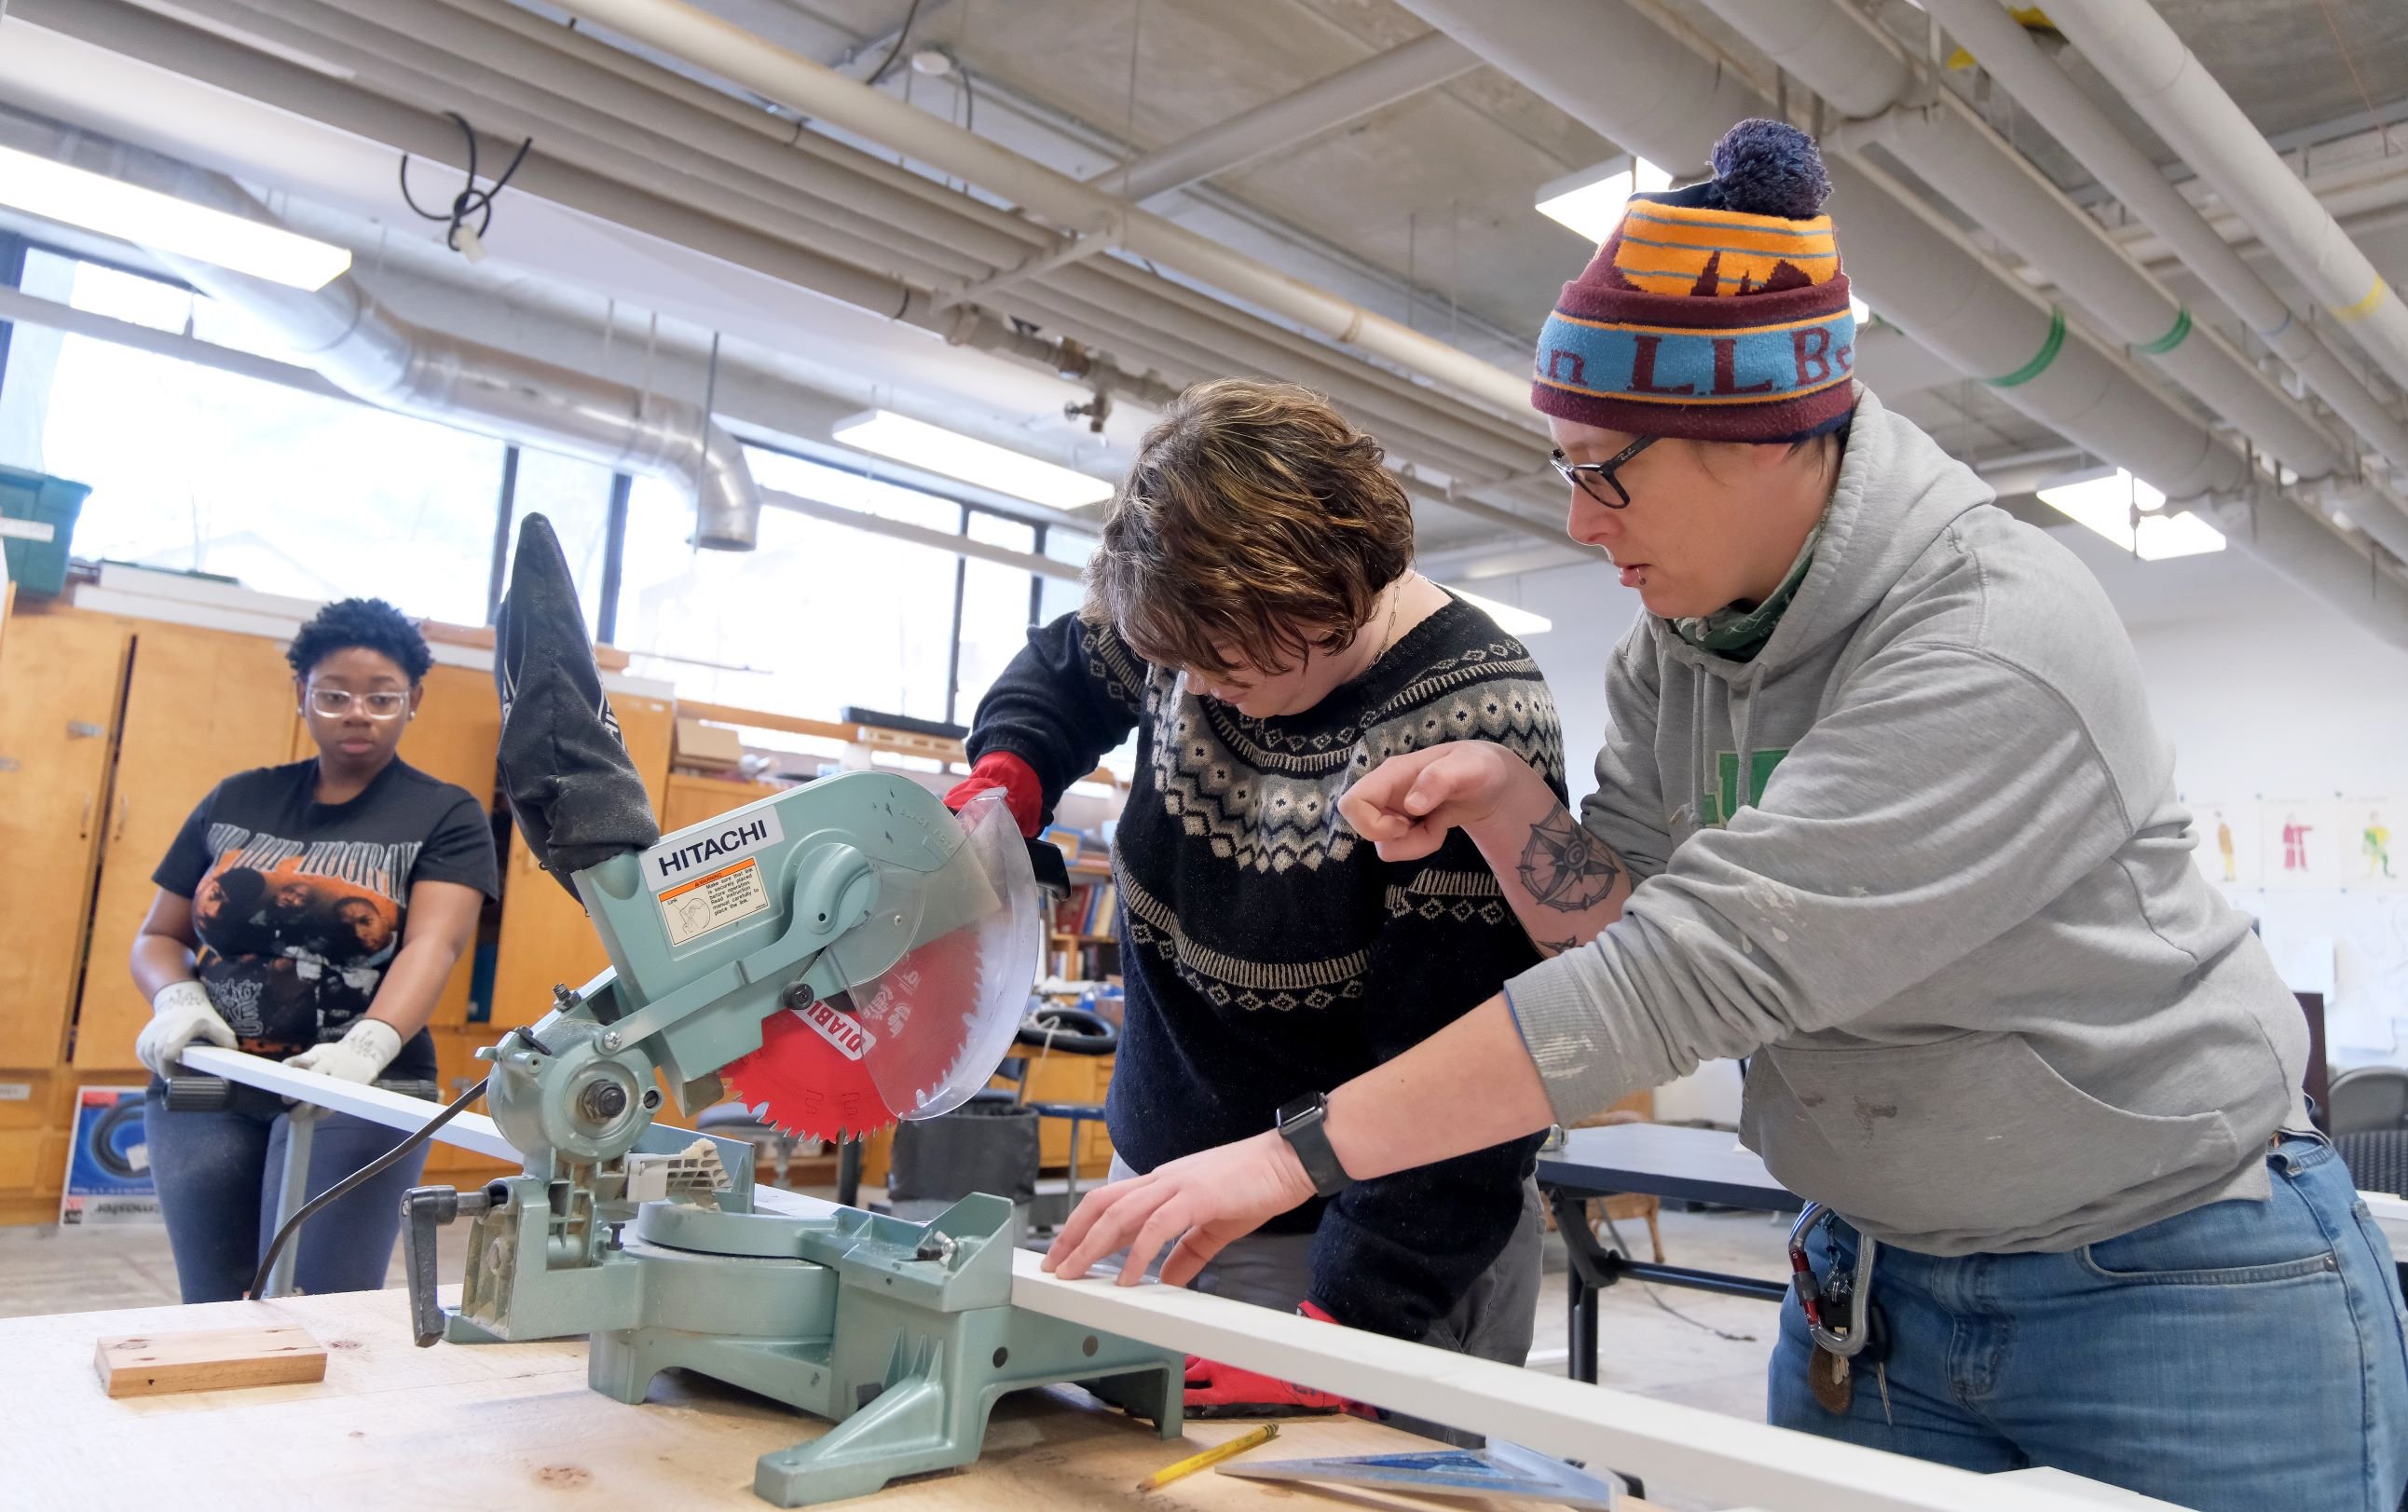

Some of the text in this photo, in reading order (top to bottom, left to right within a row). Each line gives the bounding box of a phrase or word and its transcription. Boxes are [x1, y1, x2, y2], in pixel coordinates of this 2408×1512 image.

[658, 819, 767, 877] HITACHI
[293, 839, 424, 909] HOORAY
[714, 881, 734, 892] securely
[736, 873, 753, 884] placed
[709, 891, 726, 900] before
[710, 885, 751, 905] Read instruction
[806, 999, 867, 1054] DIABL
